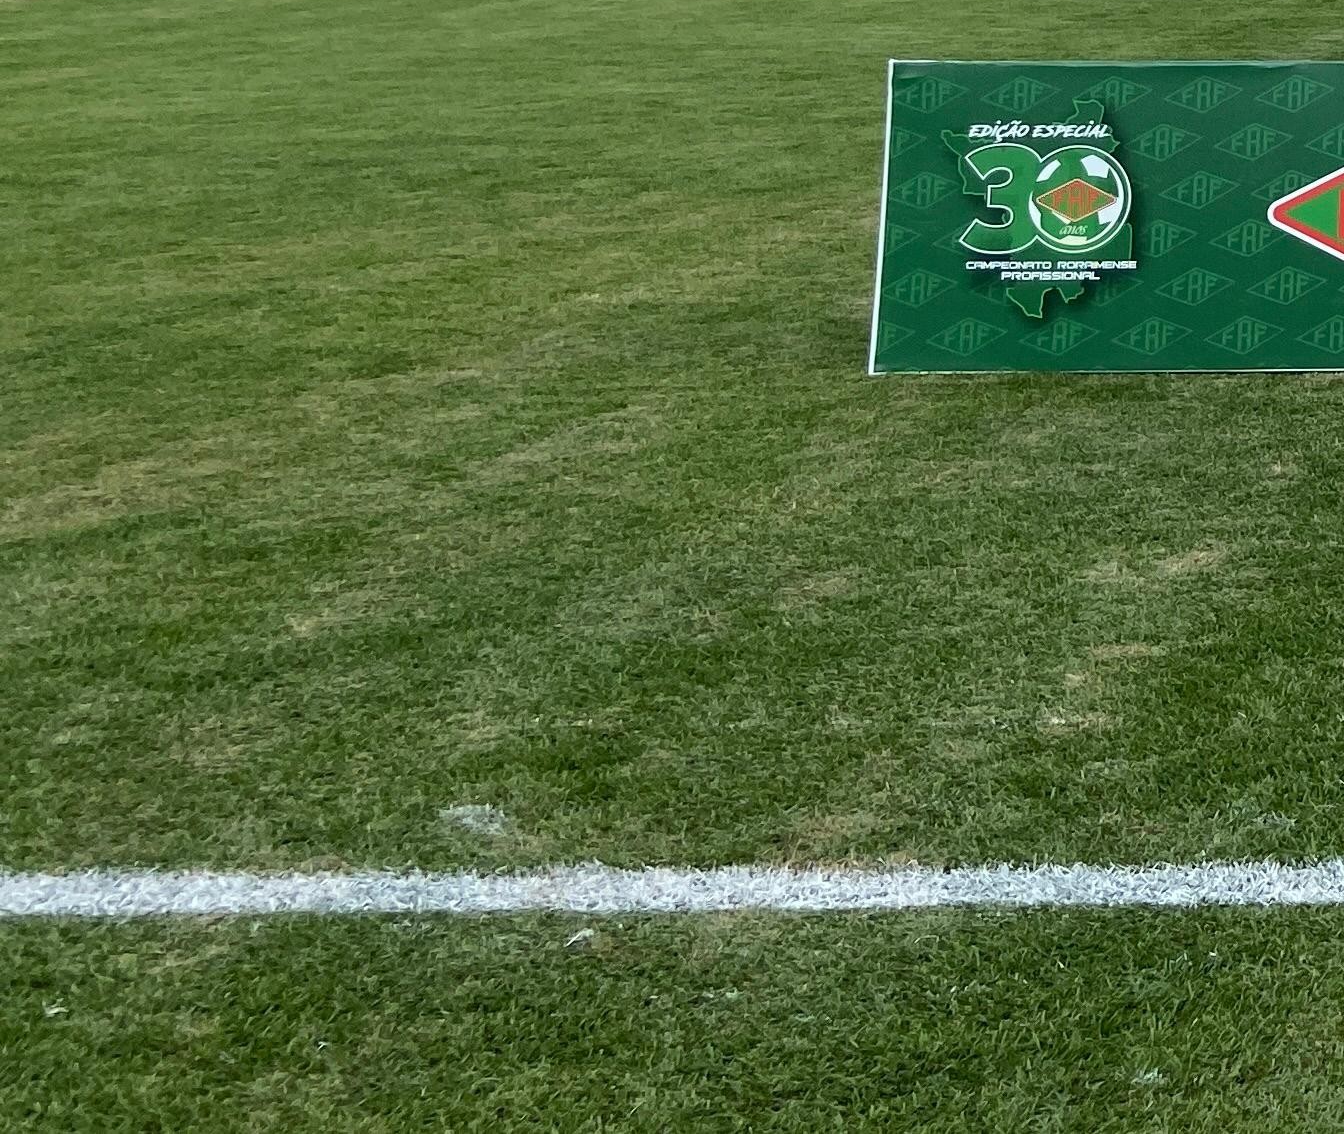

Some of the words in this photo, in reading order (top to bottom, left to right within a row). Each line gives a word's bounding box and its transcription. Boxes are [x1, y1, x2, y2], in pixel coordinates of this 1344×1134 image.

[958, 142, 1132, 254] 30
[1059, 223, 1088, 236] anos
[965, 260, 1053, 270] CAMPEONATO
[1056, 260, 1138, 270] RORAIMENSE
[1000, 271, 1101, 281] PROFISSIONAL
